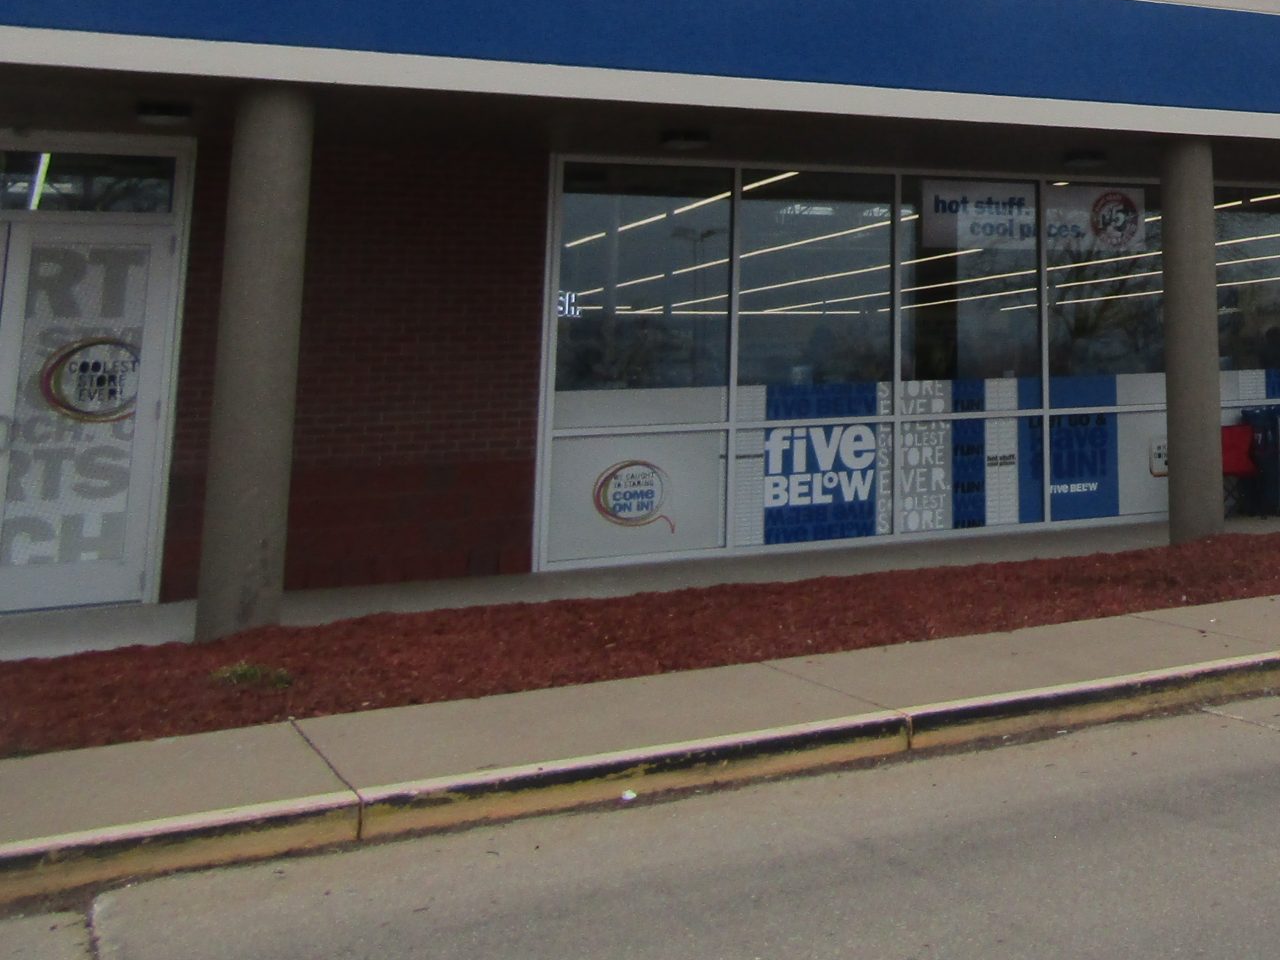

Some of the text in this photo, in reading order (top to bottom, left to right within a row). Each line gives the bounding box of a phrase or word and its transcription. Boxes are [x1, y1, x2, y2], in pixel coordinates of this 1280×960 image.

[934, 195, 1030, 216] hot stuff.
[969, 219, 1014, 236] cool
[69, 360, 137, 374] COOLEST
[78, 374, 126, 387] STORE
[78, 388, 124, 401] EVER!
[765, 424, 876, 475] five
[765, 469, 874, 508] BELOW
[613, 502, 632, 513] ON
